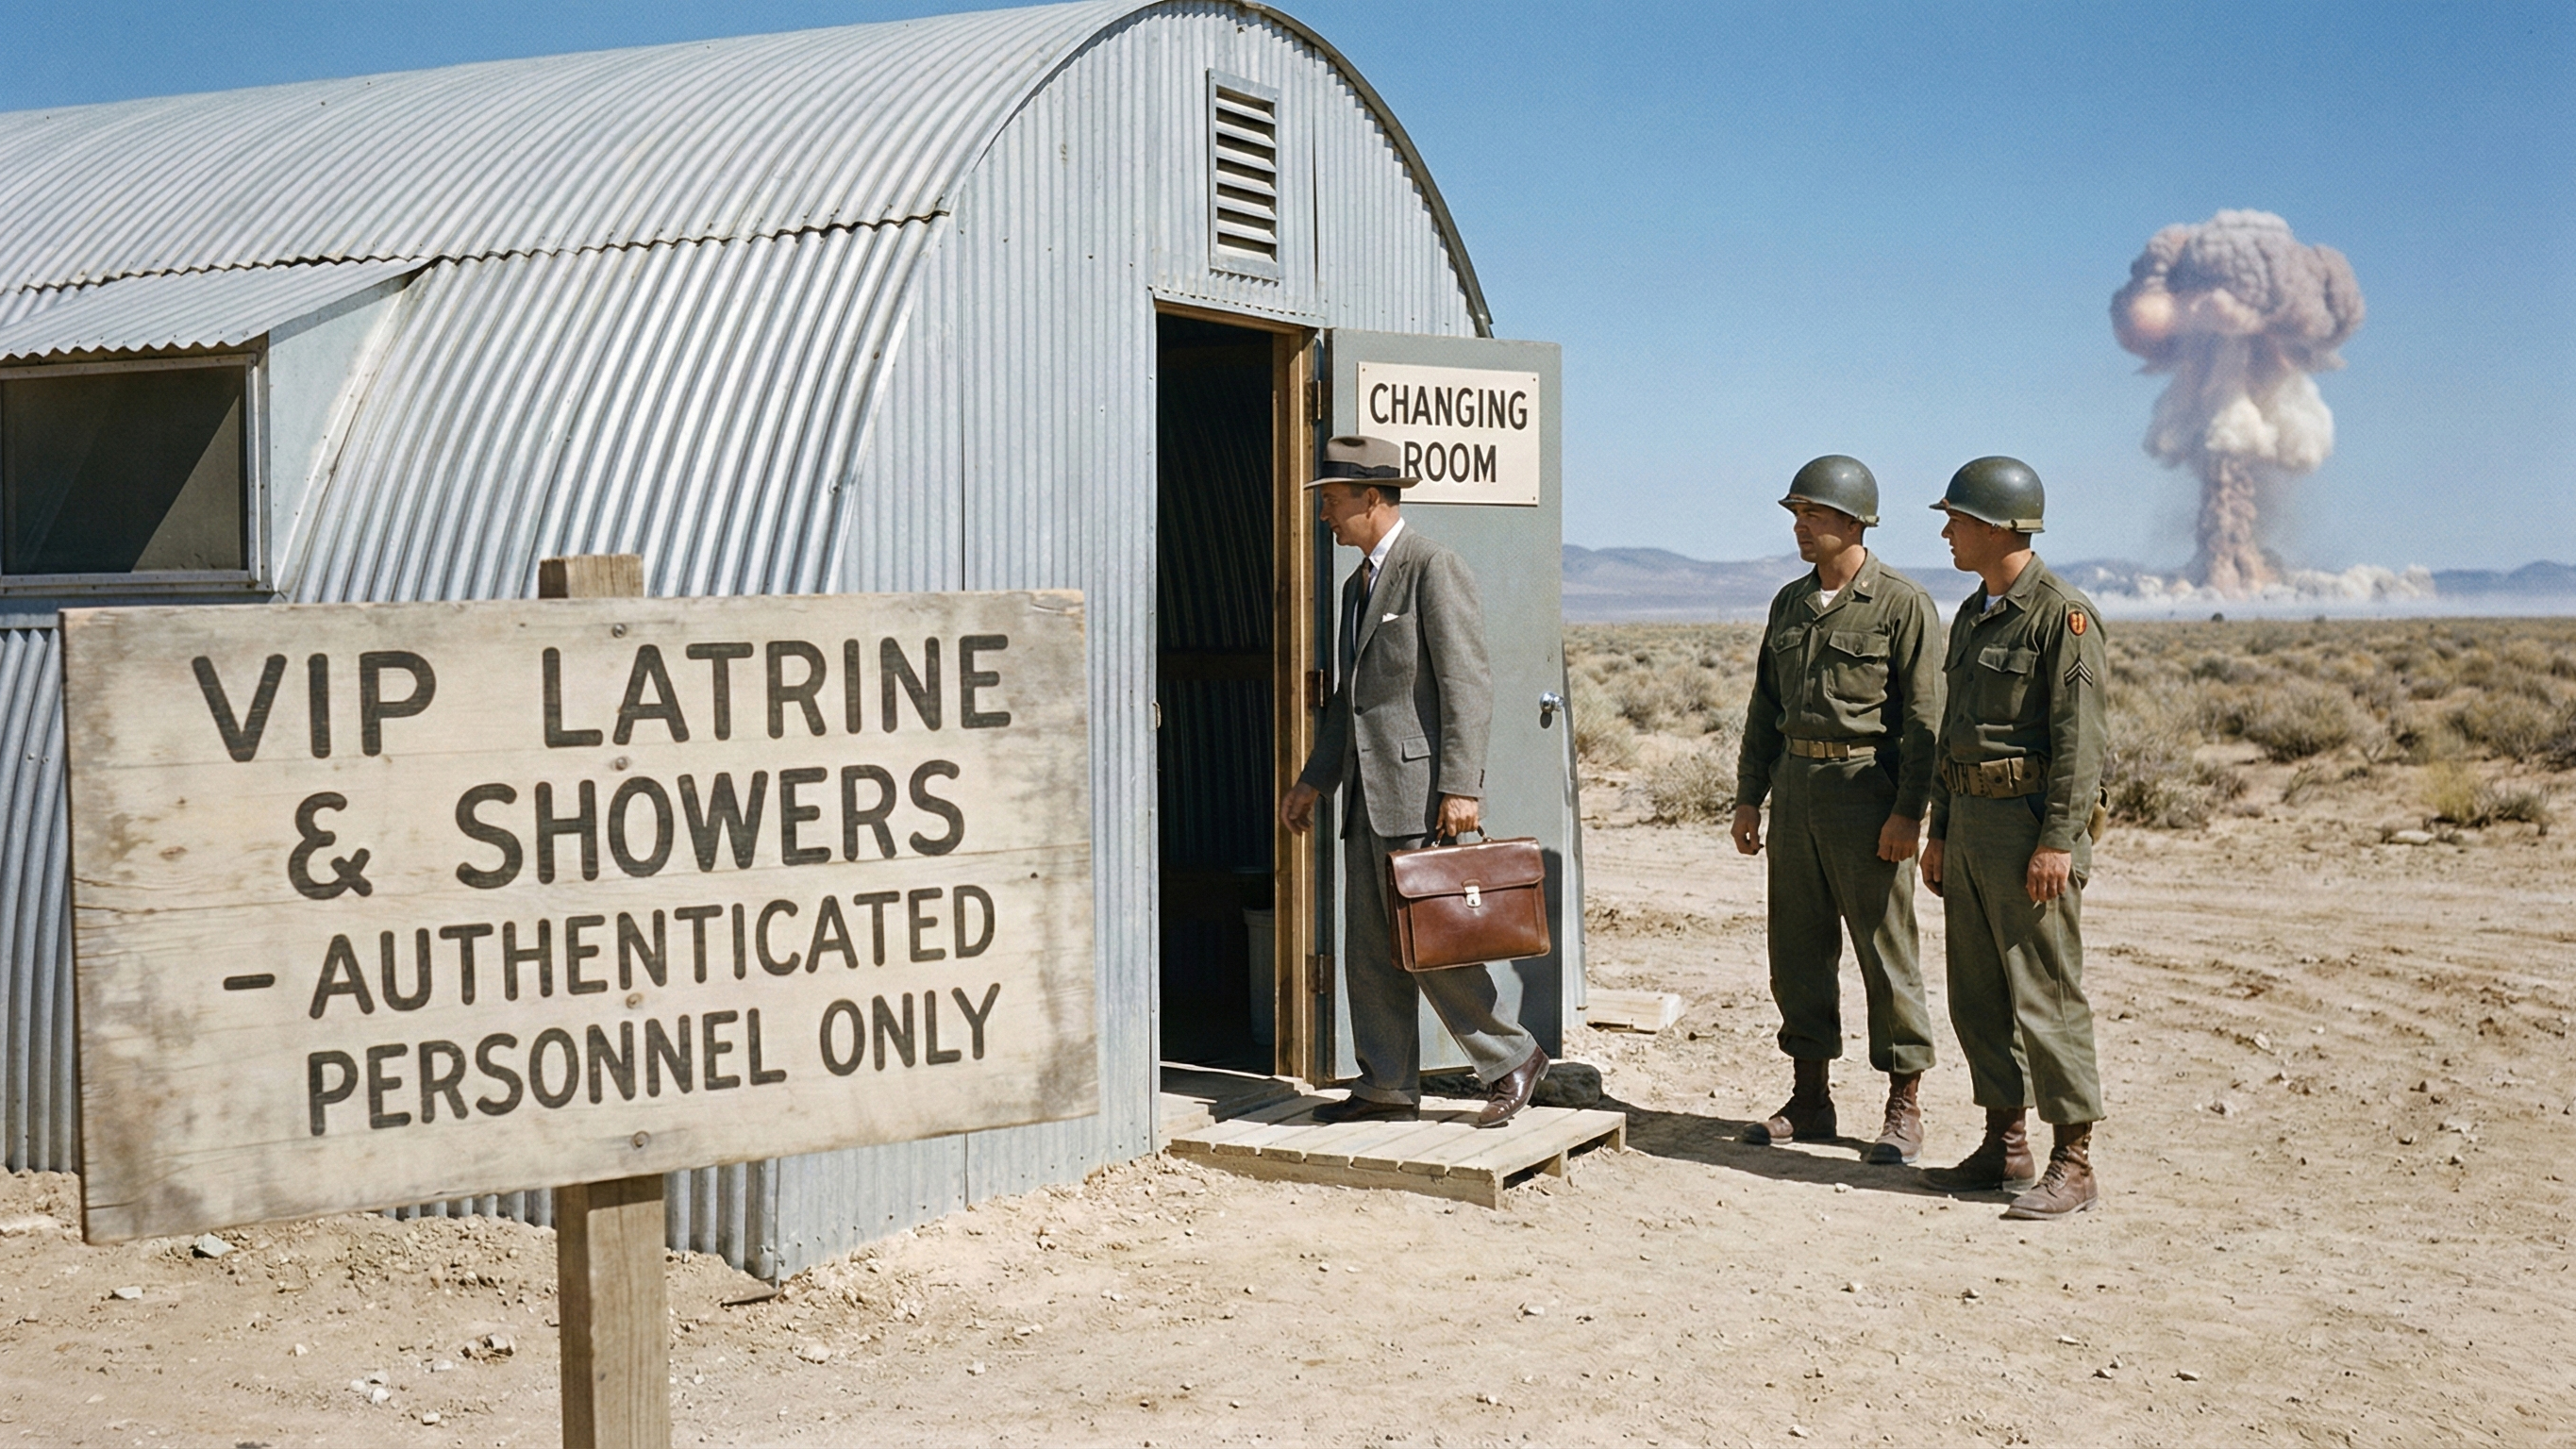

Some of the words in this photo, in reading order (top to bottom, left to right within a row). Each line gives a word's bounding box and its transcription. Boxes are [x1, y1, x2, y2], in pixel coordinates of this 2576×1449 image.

[1369, 382, 1528, 431] CHANGING
[1404, 441, 1497, 483] ROOM
[192, 650, 437, 763] VIP
[543, 633, 1013, 750] LATRINE
[288, 791, 374, 901] &
[455, 759, 966, 891] SHOWERS
[309, 884, 996, 1021] AUTHENTICATED
[309, 1008, 787, 1138] PERSONNEL
[820, 982, 1002, 1079] ONLY
